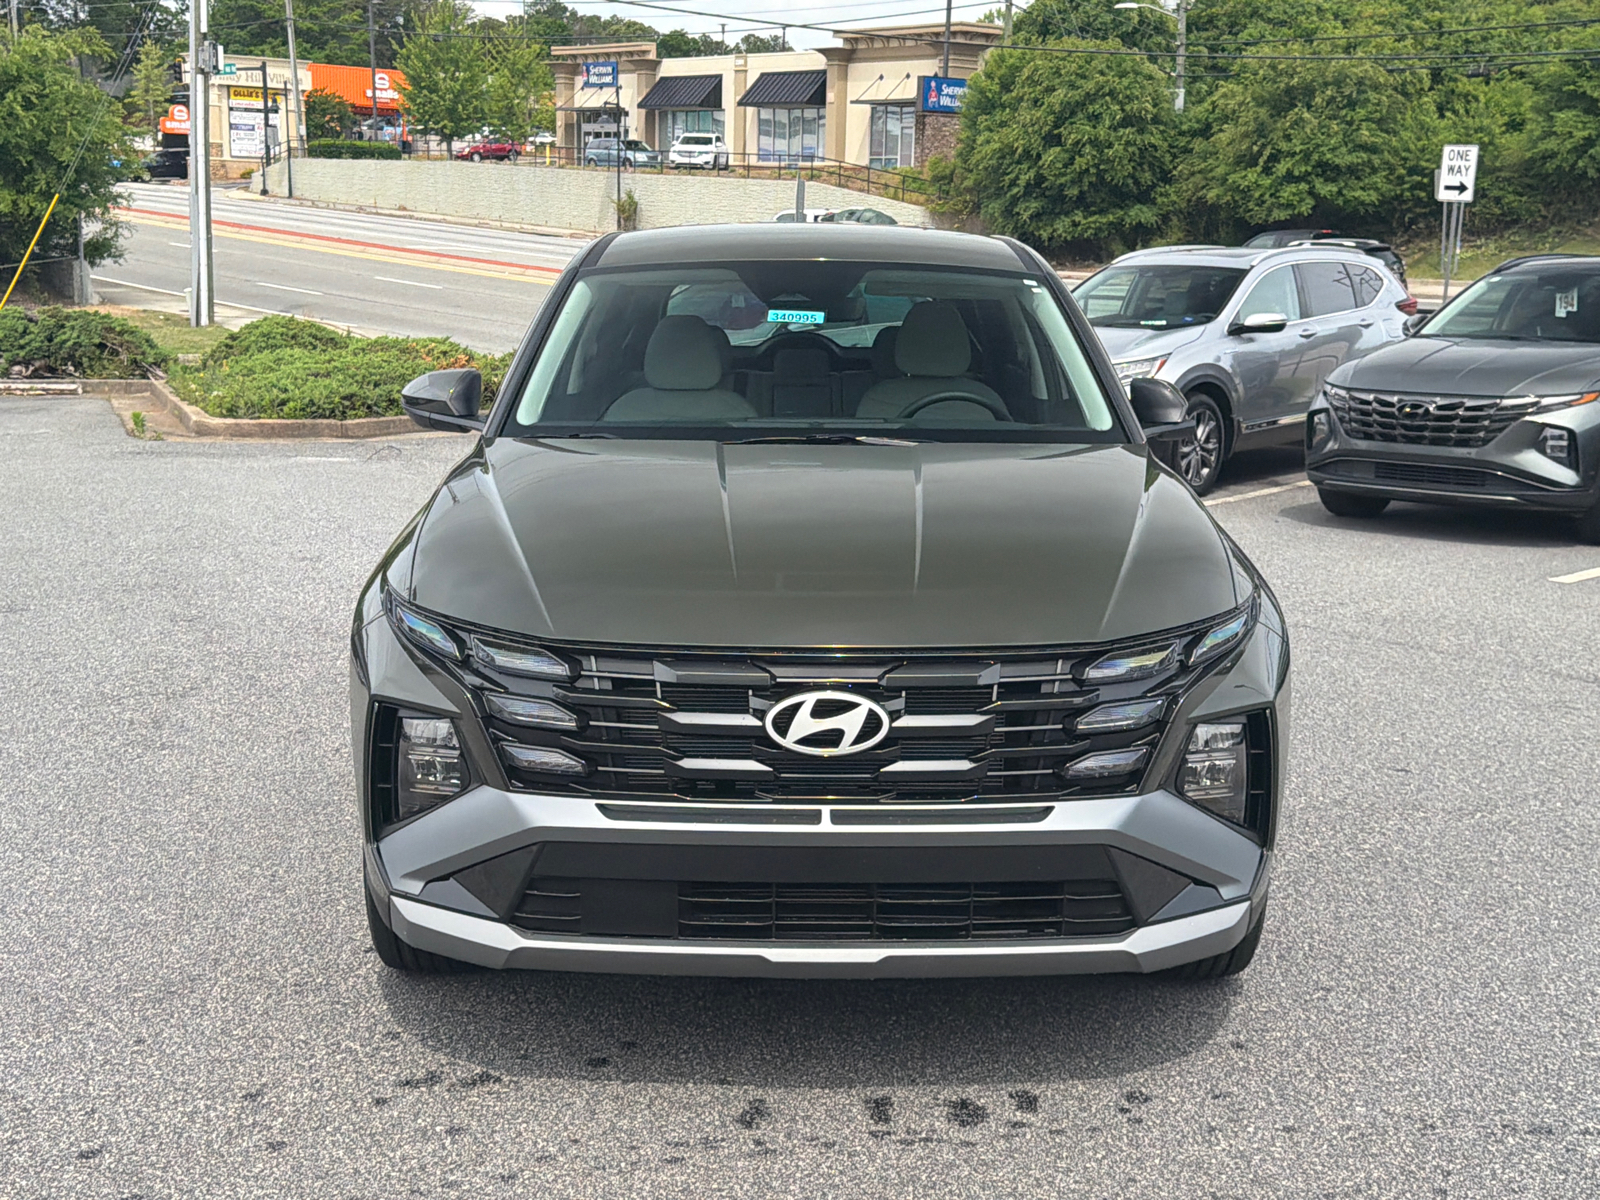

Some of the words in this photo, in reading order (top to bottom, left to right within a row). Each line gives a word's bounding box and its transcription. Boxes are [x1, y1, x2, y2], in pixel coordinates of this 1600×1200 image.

[589, 65, 613, 75] SHERWIN
[245, 72, 263, 82] Hil
[268, 73, 304, 86] Villae
[165, 120, 190, 129] small
[1448, 149, 1472, 162] ONE
[1447, 164, 1471, 177] WAY
[1558, 295, 1575, 310] 194
[771, 312, 817, 323] 340995
